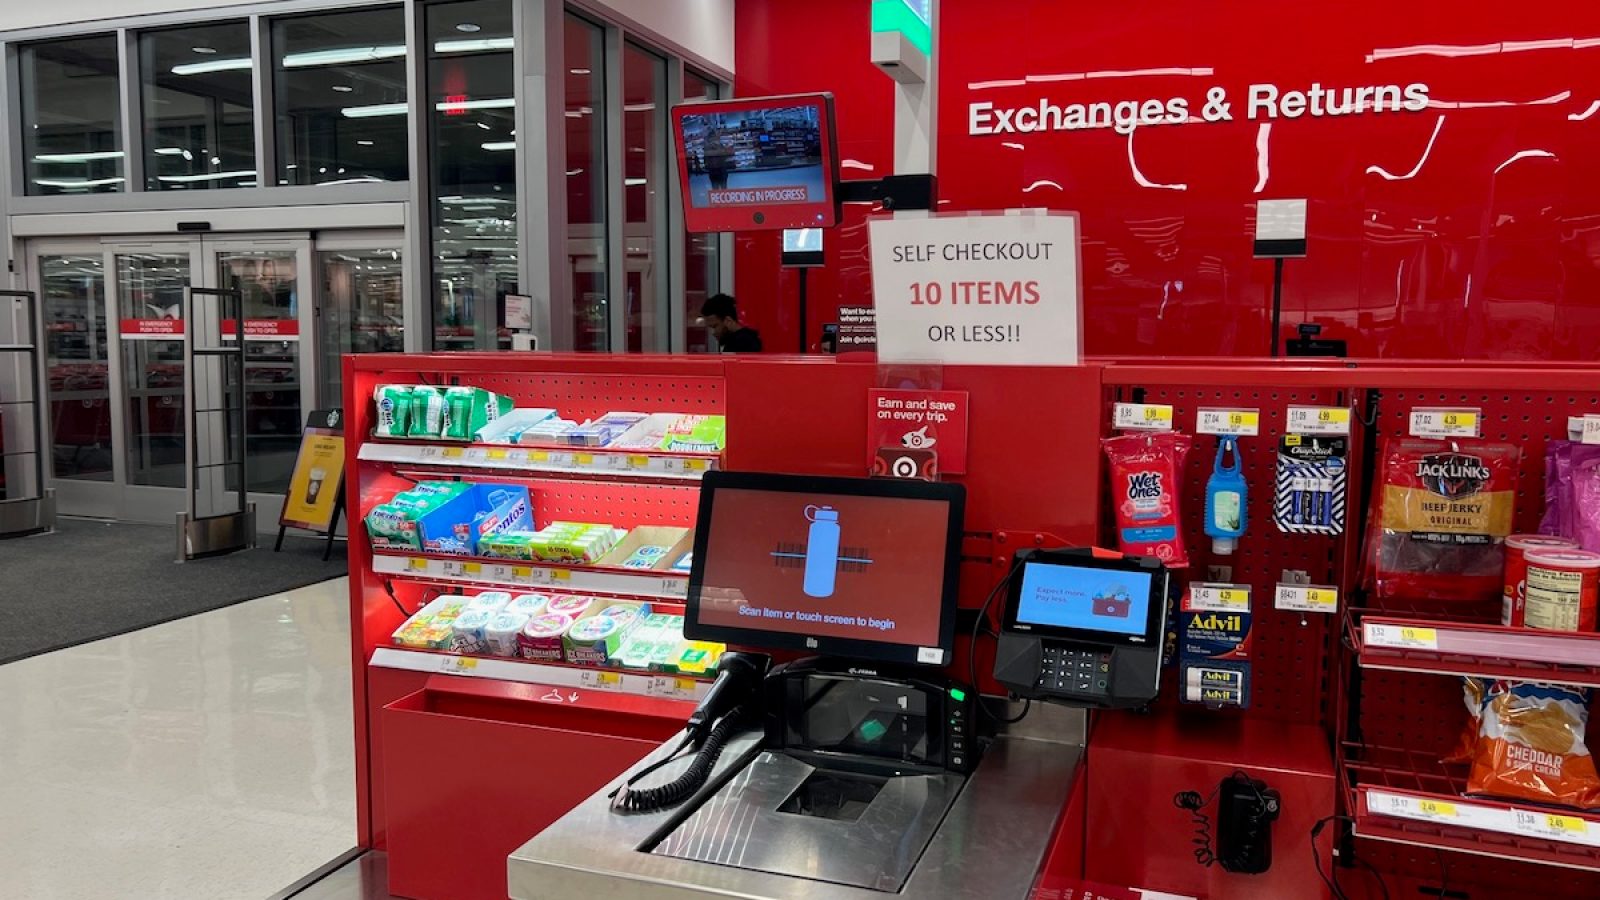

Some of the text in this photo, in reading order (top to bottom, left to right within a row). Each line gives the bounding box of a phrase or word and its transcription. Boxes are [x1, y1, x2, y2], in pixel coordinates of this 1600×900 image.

[968, 82, 1429, 136] Exchanges & Returns
[710, 188, 805, 204] RECORDING IN PROGRESS
[893, 243, 1053, 262] SELF CHECKOUT
[910, 281, 1041, 305] 10 ITEMS
[840, 307, 858, 316] Want
[859, 307, 865, 316] to
[859, 316, 872, 324] you
[928, 324, 1020, 342] OR LESS!!
[877, 397, 956, 411] Earn and save
[877, 410, 948, 423] on every trip.
[1416, 463, 1449, 478] JACK
[1129, 472, 1161, 488] Wet
[1128, 485, 1161, 499] Ones
[1421, 502, 1483, 514] BEEF JERKY
[1430, 516, 1472, 526] ORIGINAL
[1037, 586, 1064, 594] Expect
[738, 605, 895, 630] Scan item or touch screen to begin
[1187, 613, 1241, 631] Advil
[1204, 671, 1231, 681] Advil
[1204, 690, 1231, 700] Advil
[1507, 744, 1563, 769] CHEDDAR
[1534, 764, 1561, 777] CREAM
